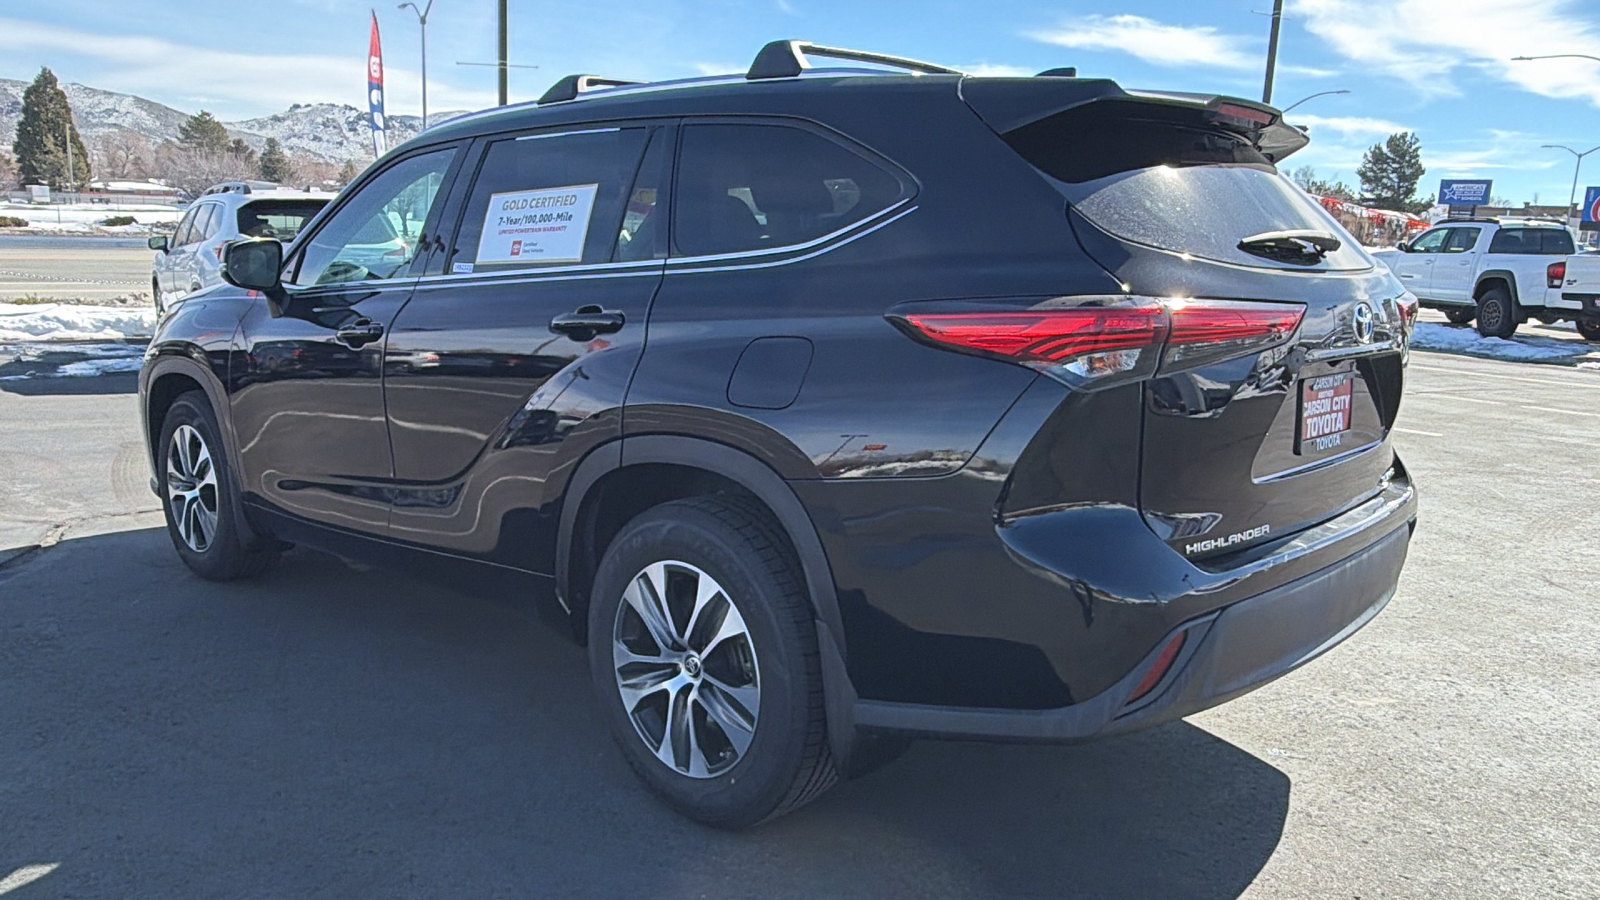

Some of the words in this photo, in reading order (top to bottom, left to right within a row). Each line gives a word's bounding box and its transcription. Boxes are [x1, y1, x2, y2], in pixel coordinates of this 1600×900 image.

[502, 199, 528, 211] GOLD
[529, 194, 577, 209] CERTIFIED
[498, 212, 573, 226] 7-Year/100,000-Mile
[1333, 395, 1350, 411] CITY
[1307, 412, 1343, 438] TOYOTA
[1316, 434, 1340, 451] TOYOTA
[1185, 524, 1270, 555] HIGHLANDER
